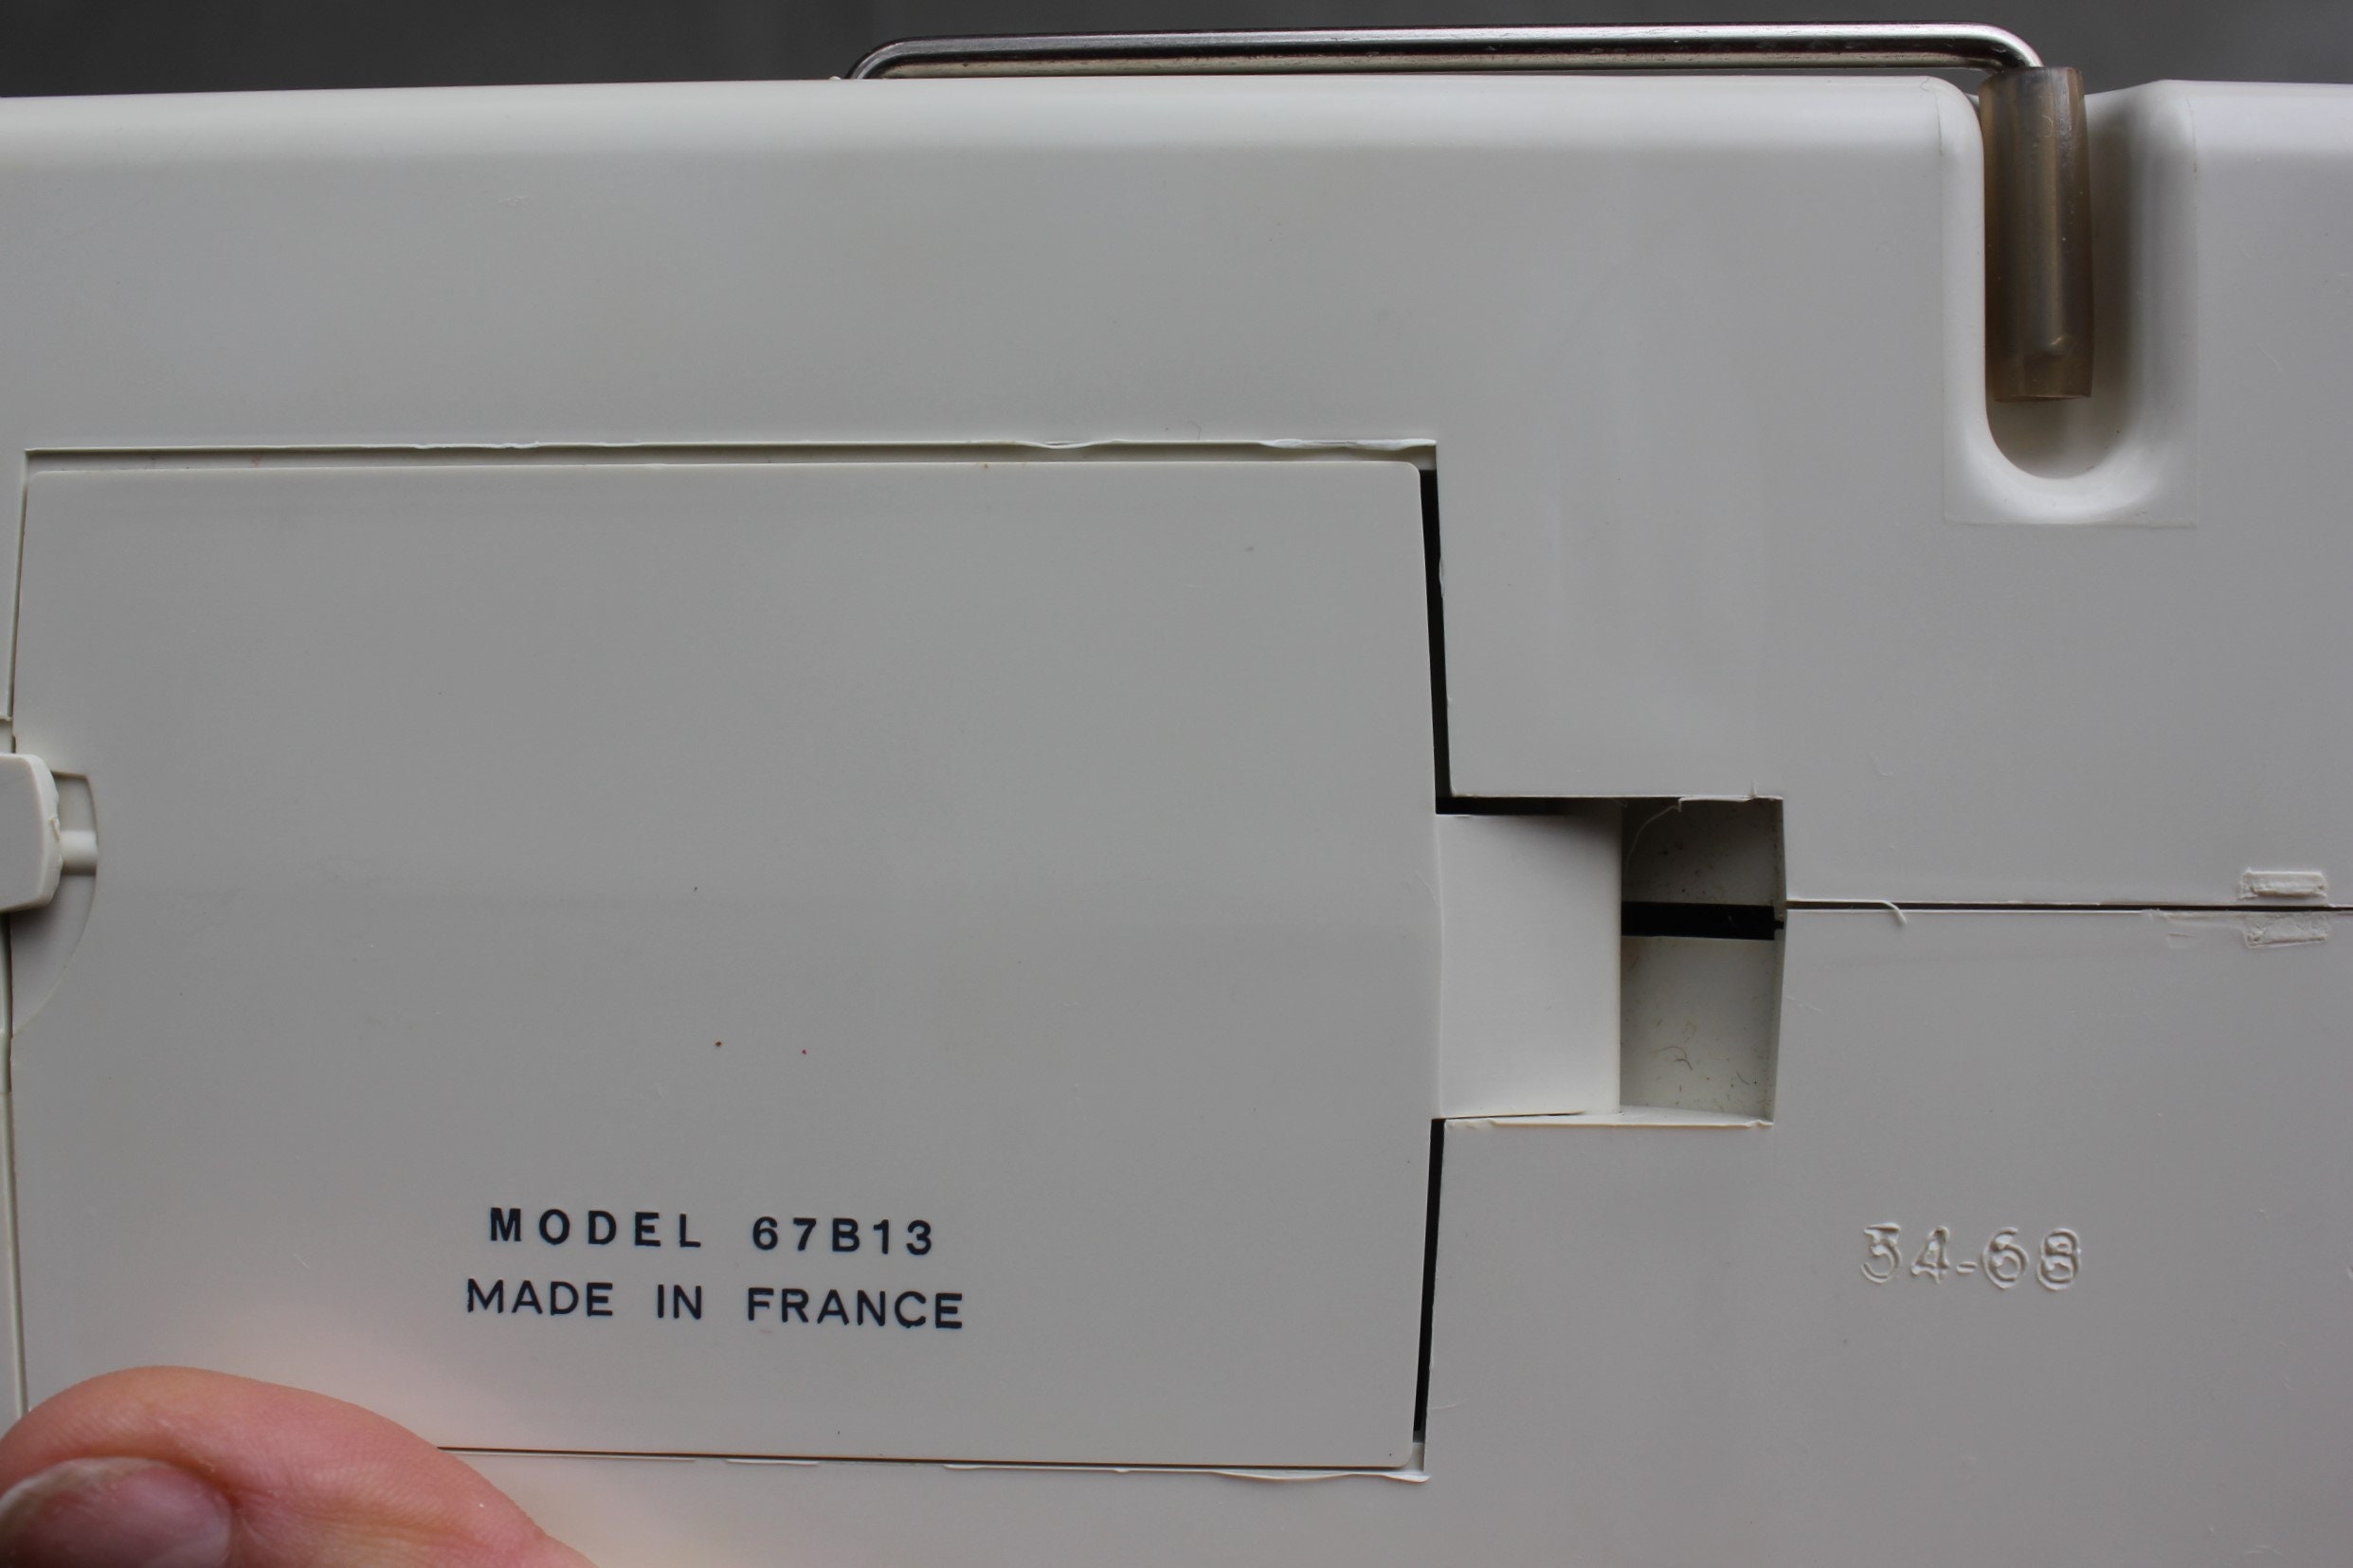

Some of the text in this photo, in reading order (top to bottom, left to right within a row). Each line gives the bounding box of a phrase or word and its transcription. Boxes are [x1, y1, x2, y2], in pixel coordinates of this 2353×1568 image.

[489, 1206, 932, 1256] MODEL 67B13
[466, 1277, 964, 1330] MADE IN FRANCE
